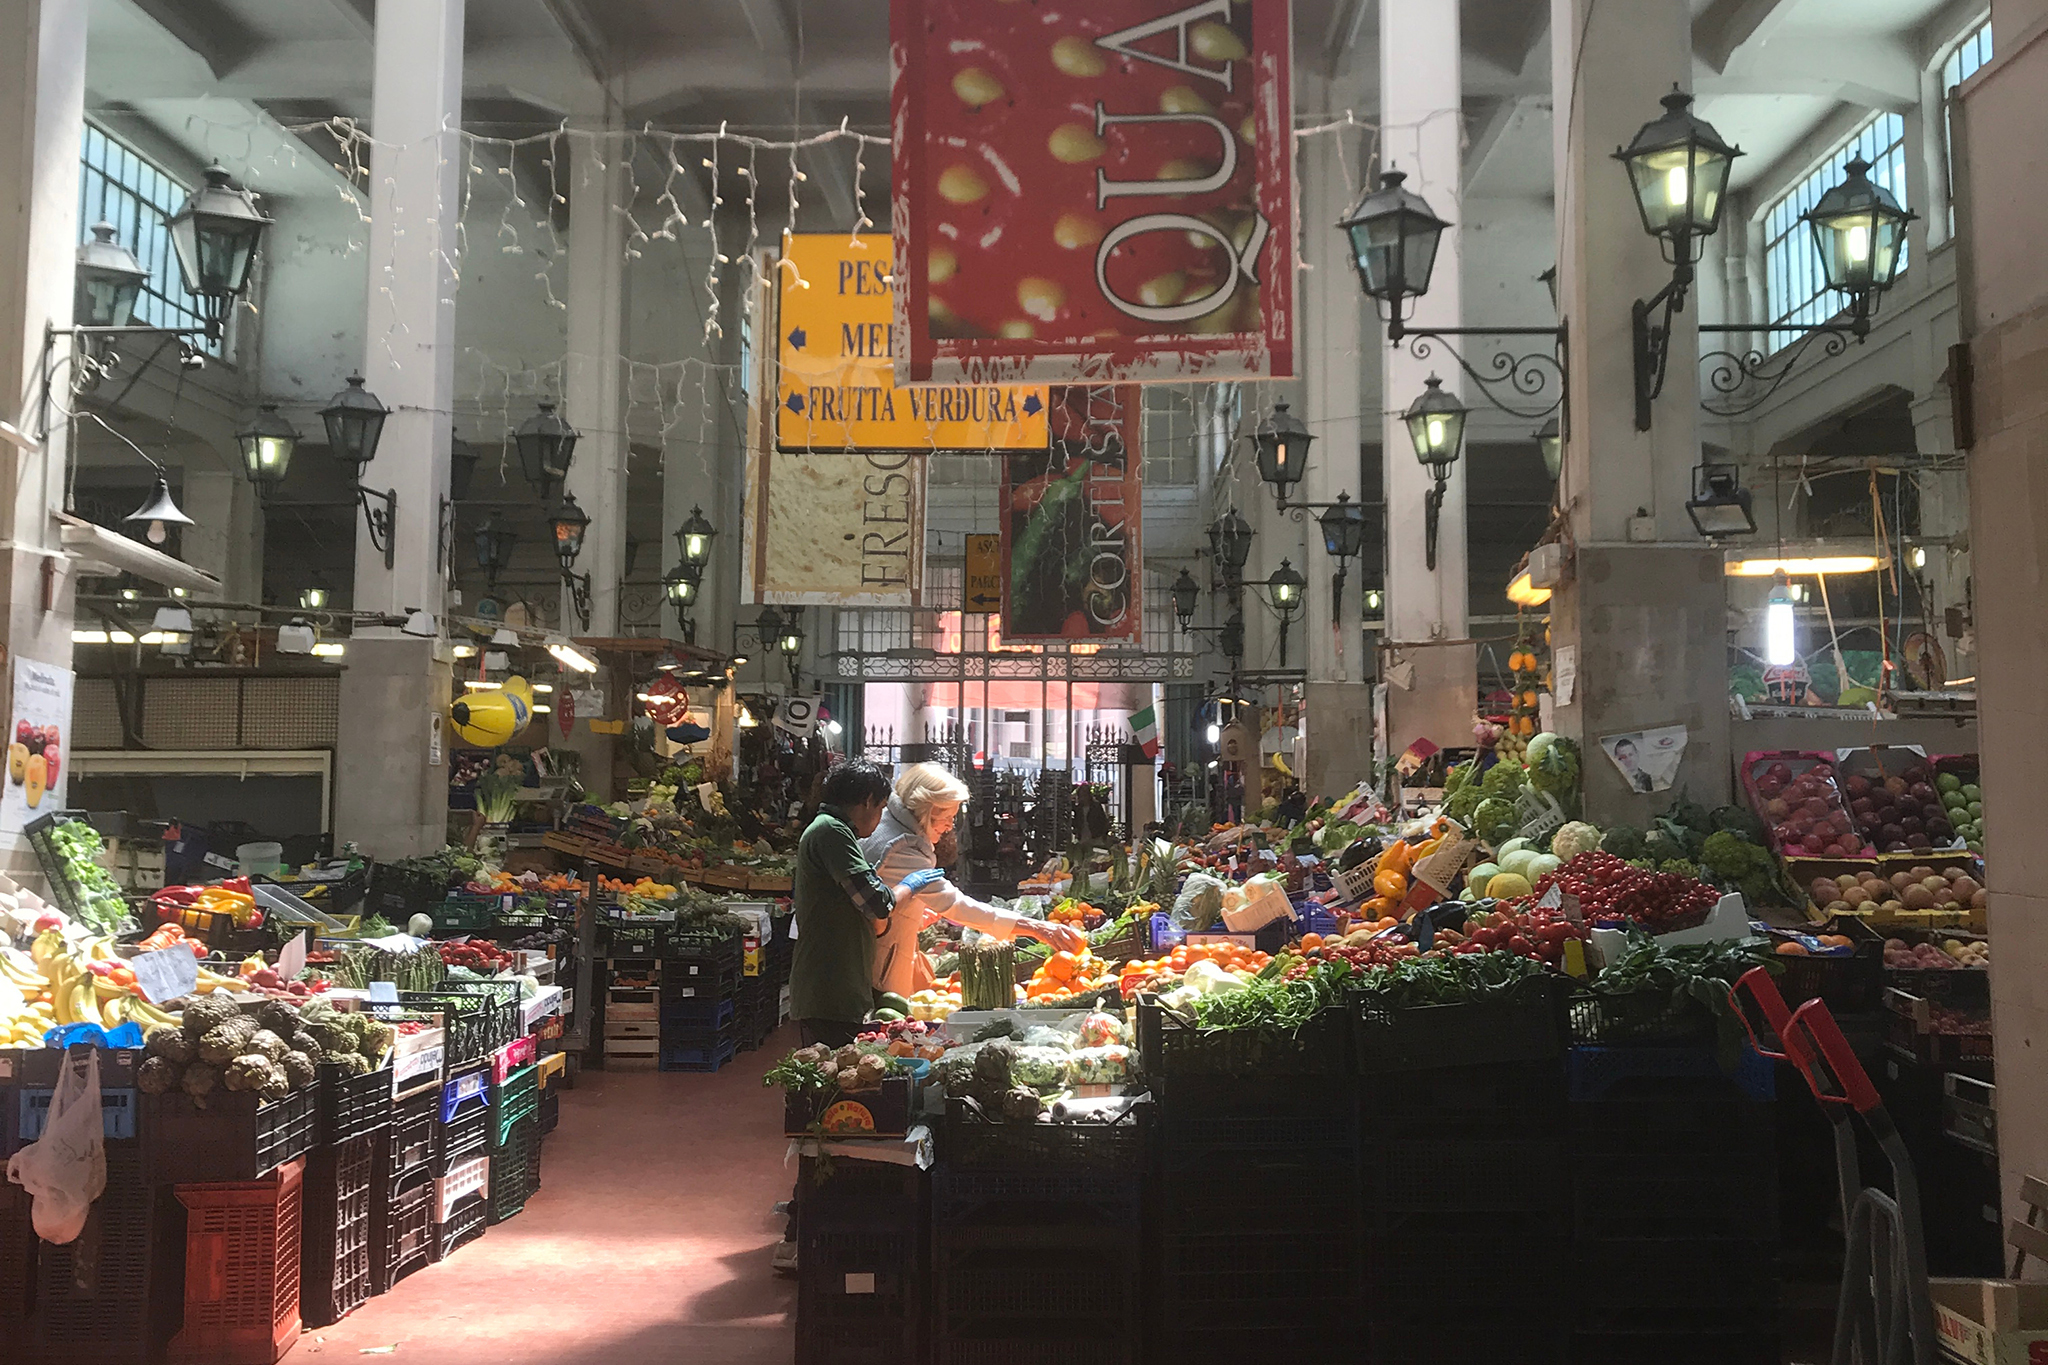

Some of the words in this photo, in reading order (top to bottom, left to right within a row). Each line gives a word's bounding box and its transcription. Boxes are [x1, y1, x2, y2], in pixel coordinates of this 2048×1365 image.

[1093, 0, 1271, 322] QUA
[837, 260, 893, 296] PES
[808, 386, 896, 422] FRUTTA
[910, 385, 1018, 422] VERDURA
[1090, 384, 1127, 626] CORTESIA
